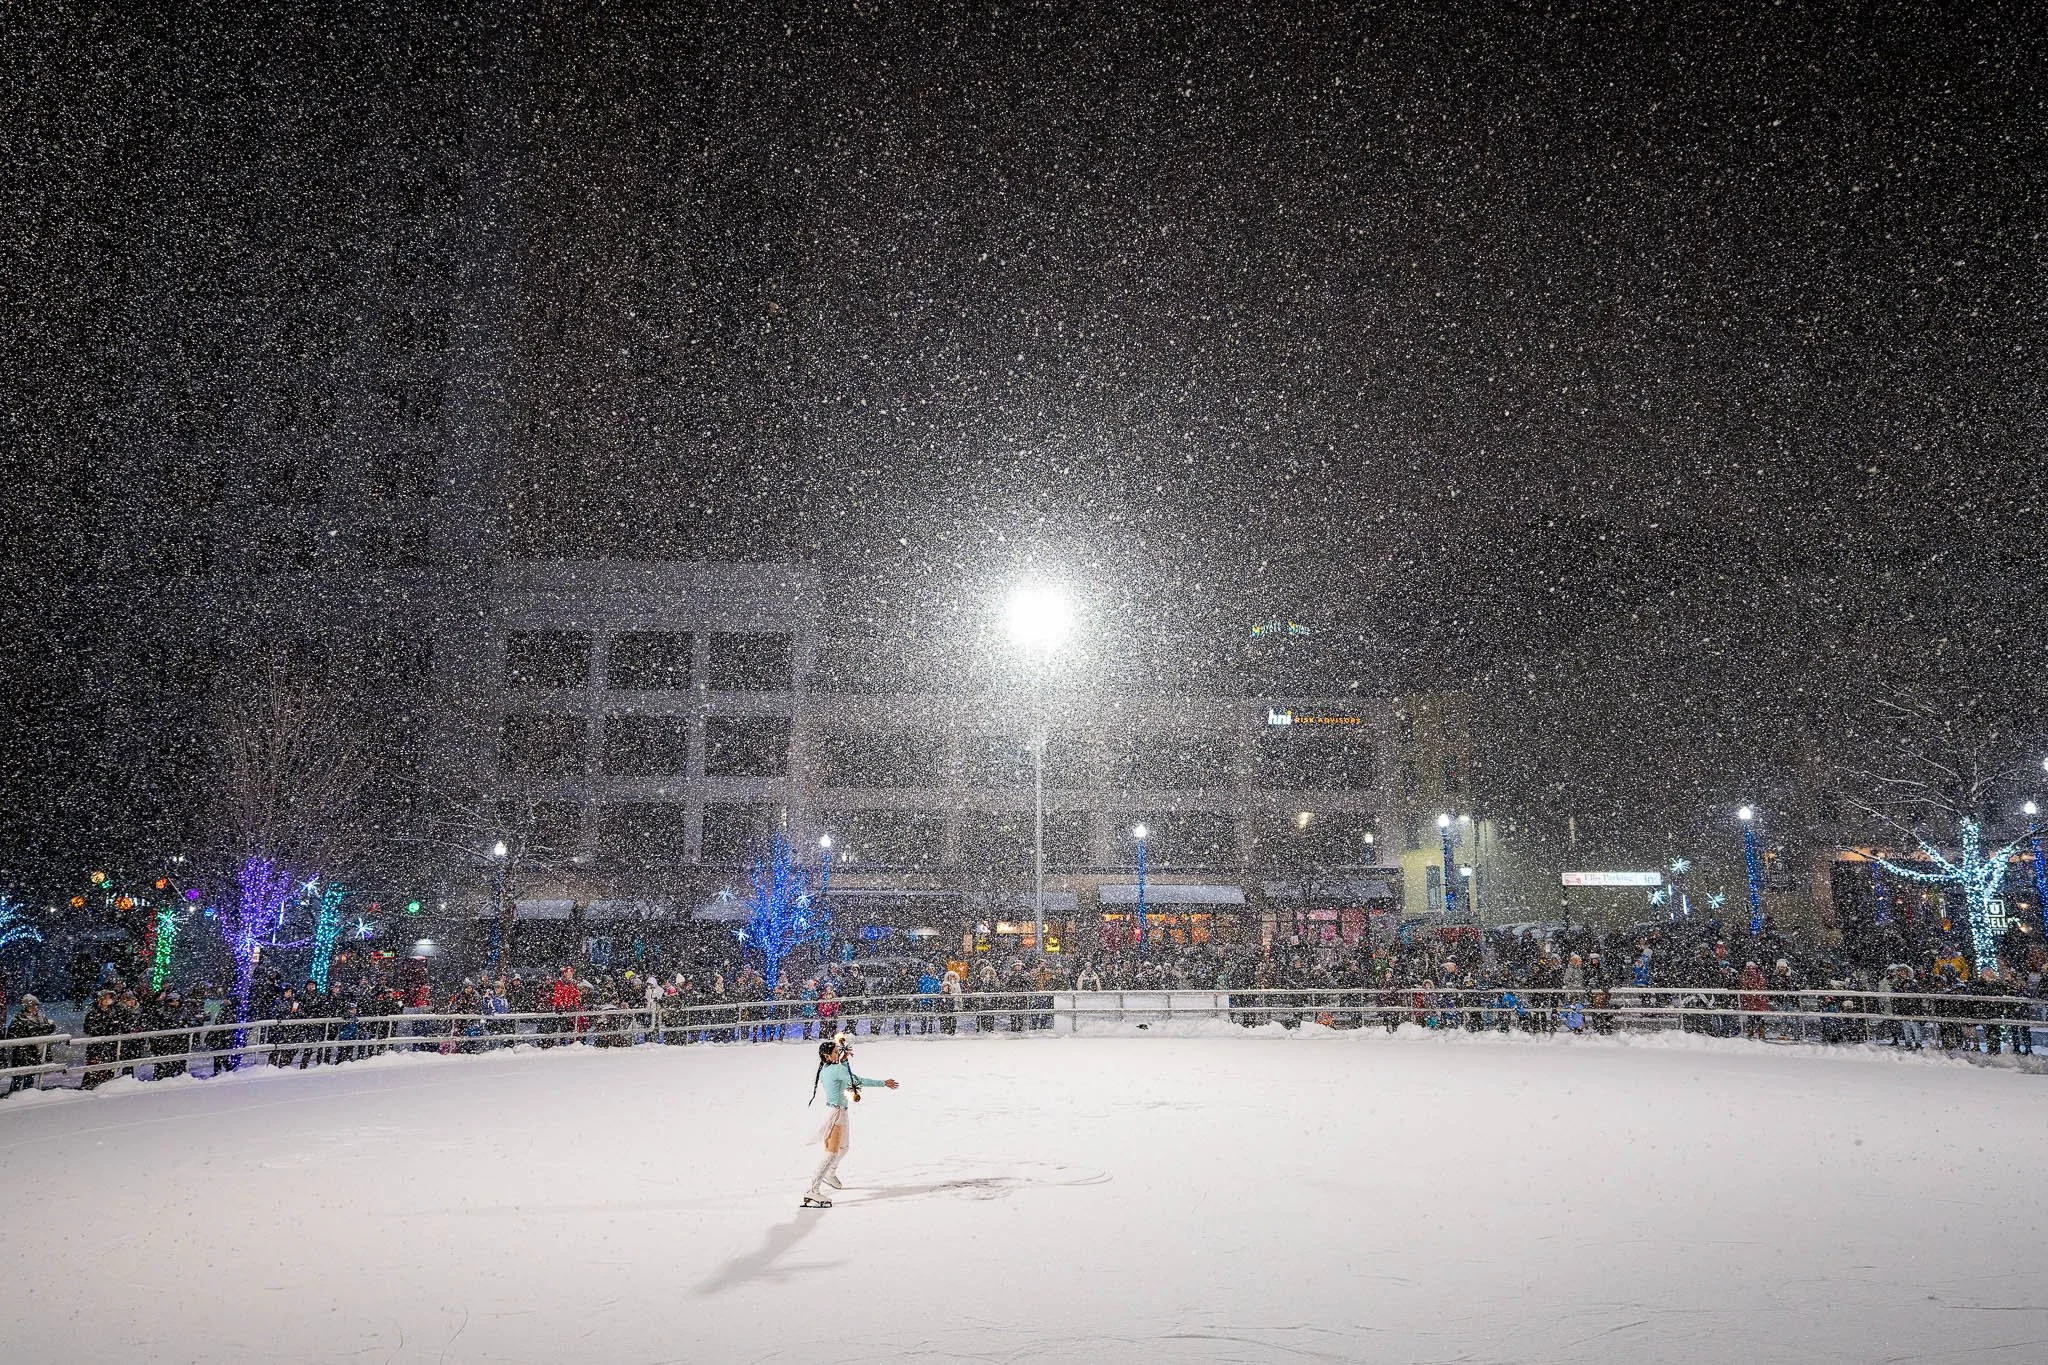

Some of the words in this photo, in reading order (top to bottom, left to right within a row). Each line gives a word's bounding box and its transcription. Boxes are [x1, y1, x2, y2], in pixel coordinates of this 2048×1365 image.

[1268, 709, 1292, 724] hni
[1294, 716, 1314, 724] RISK
[1317, 716, 1361, 724] ADVISORS
